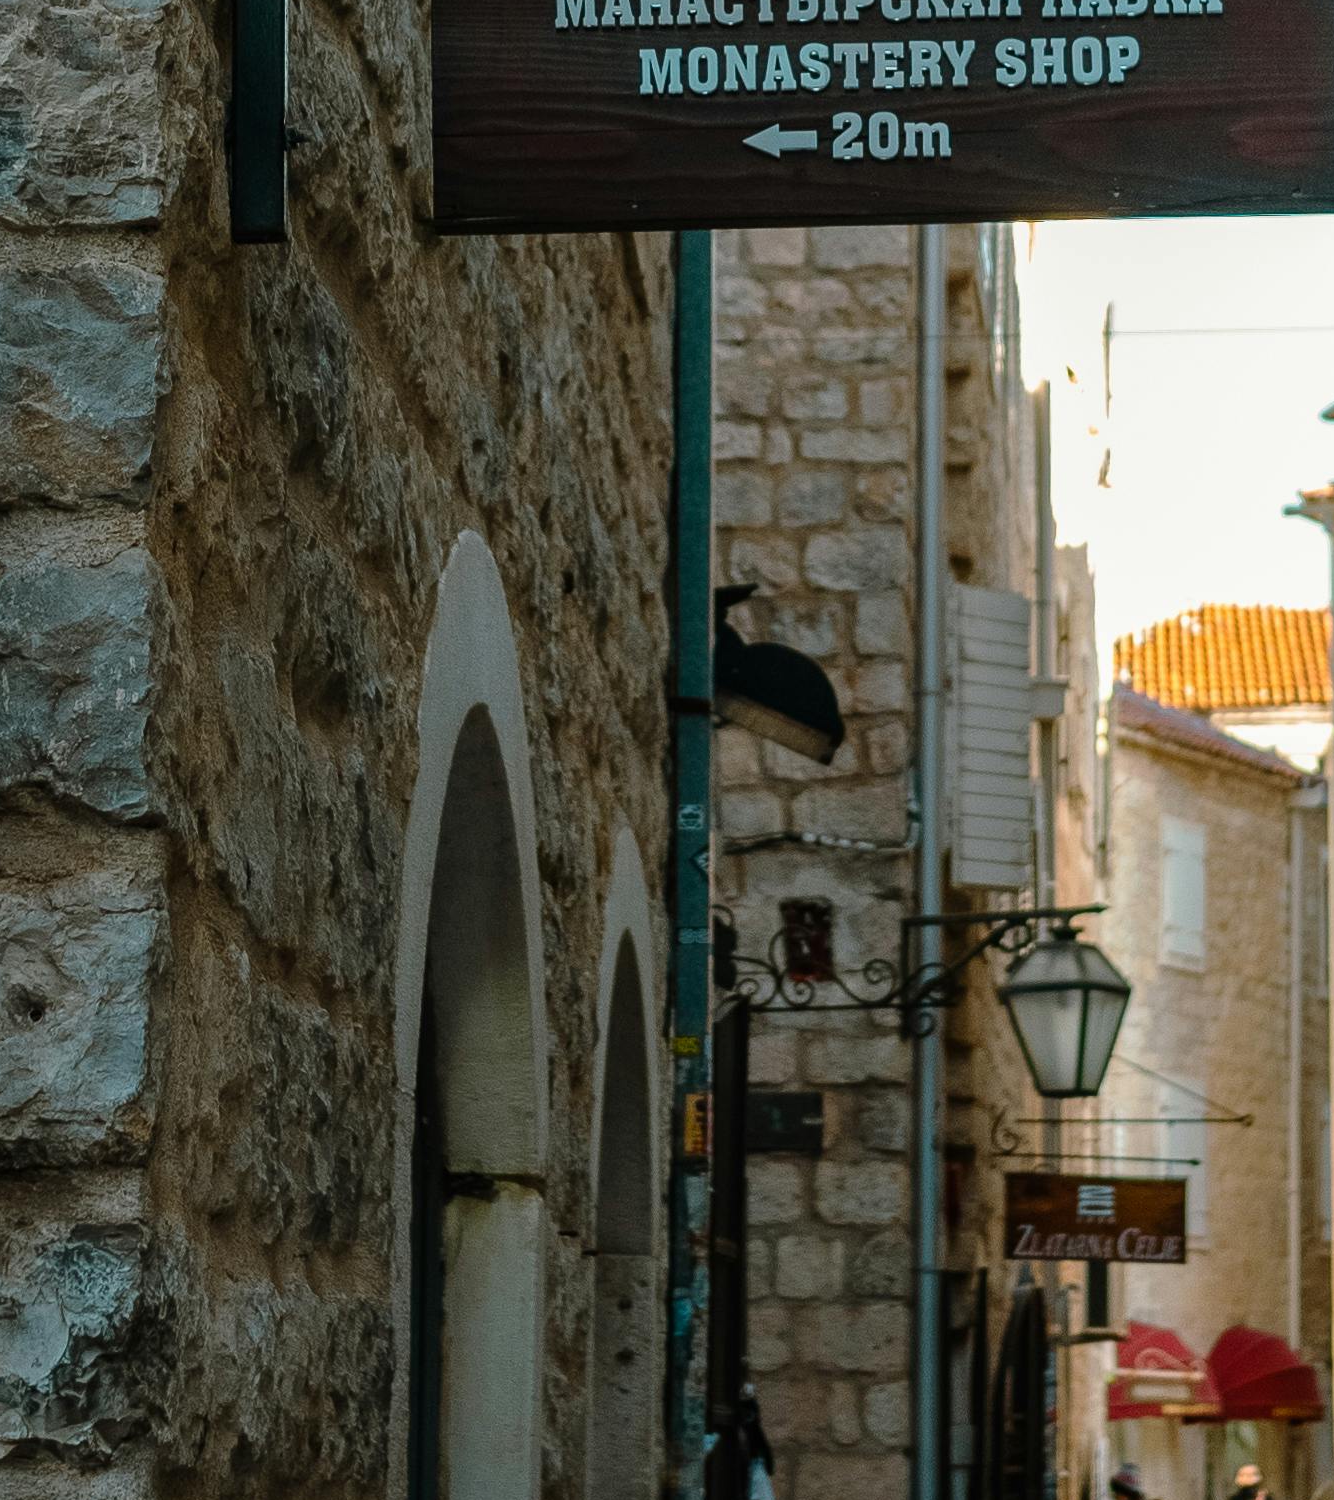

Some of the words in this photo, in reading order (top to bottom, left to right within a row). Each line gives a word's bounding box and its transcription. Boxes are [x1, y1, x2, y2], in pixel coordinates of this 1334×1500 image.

[638, 37, 977, 96] MONASTERY
[995, 35, 1142, 87] SHOP
[831, 111, 953, 161] 20m
